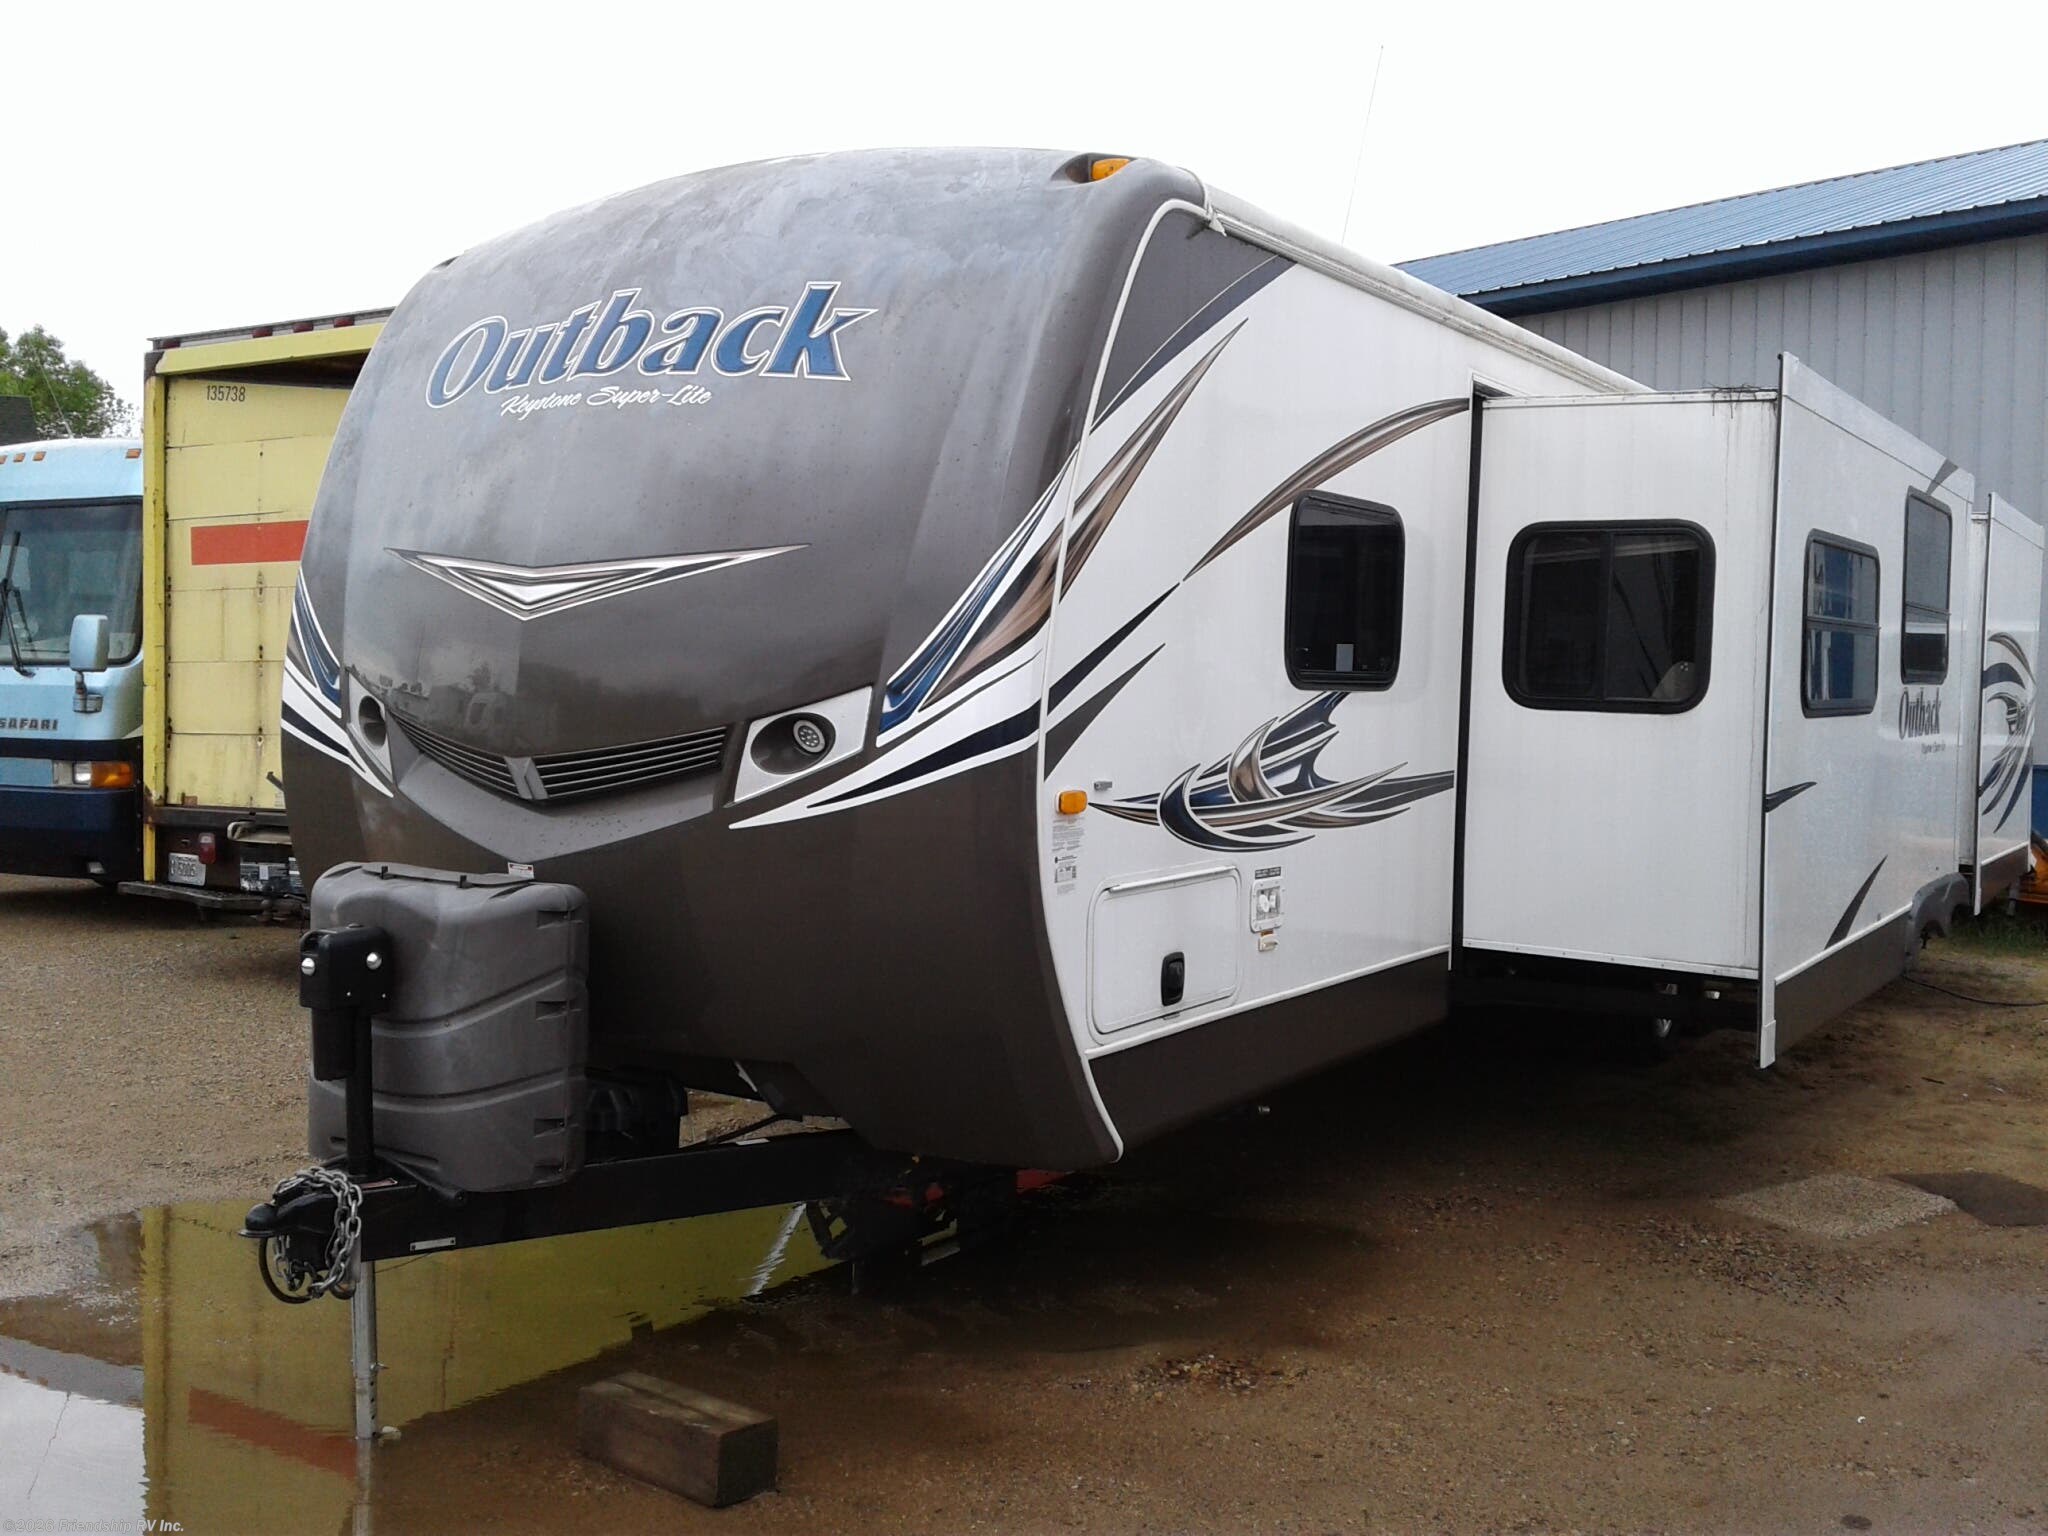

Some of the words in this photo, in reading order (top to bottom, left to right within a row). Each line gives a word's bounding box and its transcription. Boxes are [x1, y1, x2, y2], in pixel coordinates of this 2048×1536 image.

[425, 280, 879, 409] Outback
[207, 385, 246, 402] 135738
[501, 392, 583, 421] Keystone
[586, 384, 714, 409] Super-Lite
[0, 717, 58, 731] SAFARI
[1898, 687, 1942, 740] Outback
